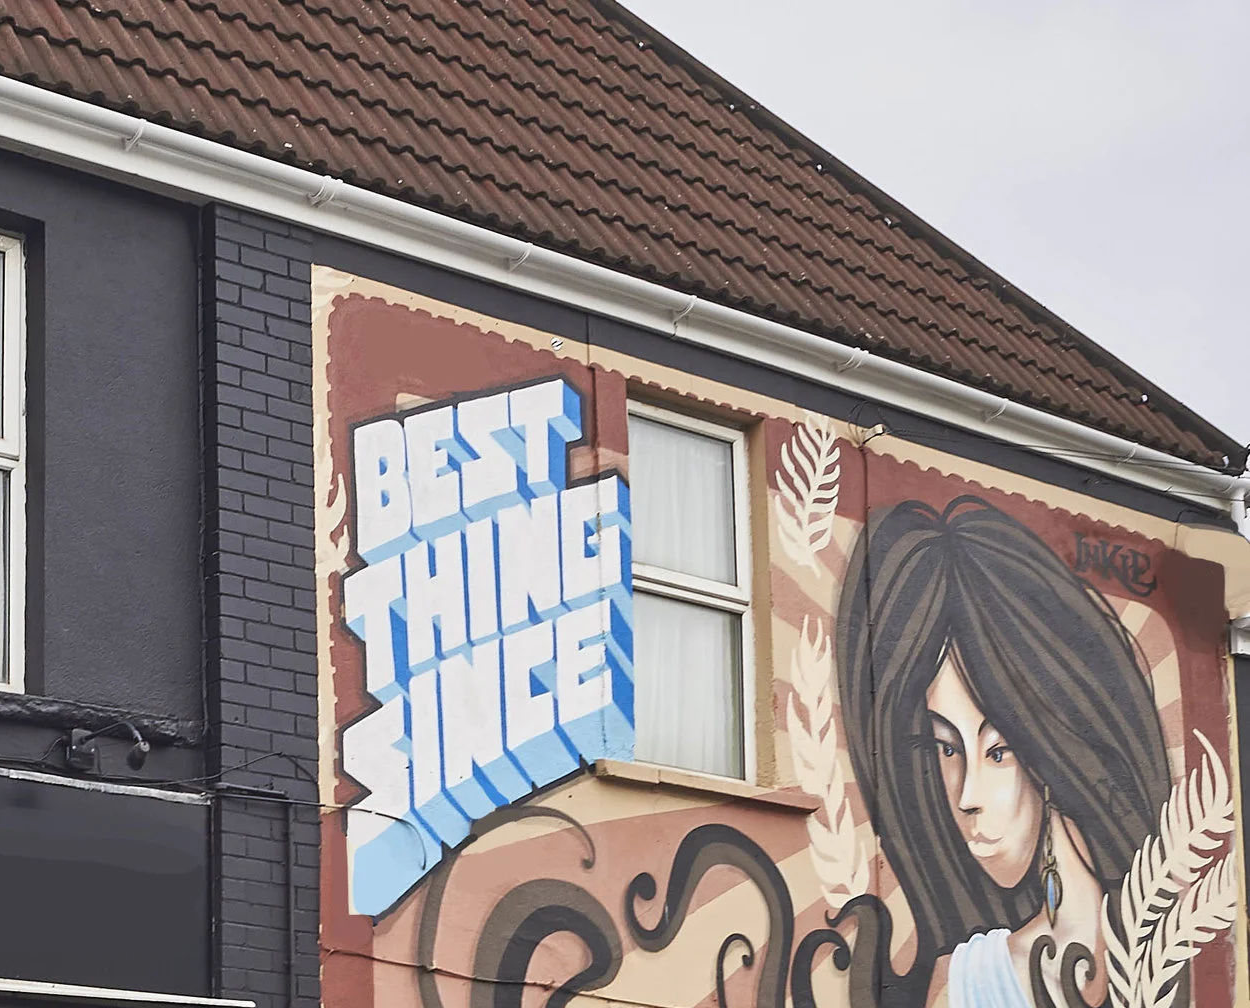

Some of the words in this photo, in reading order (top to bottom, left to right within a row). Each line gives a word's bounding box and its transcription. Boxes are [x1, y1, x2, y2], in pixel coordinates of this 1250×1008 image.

[354, 380, 572, 548] BEST
[345, 476, 623, 695] THING
[343, 600, 610, 905] SINCE
